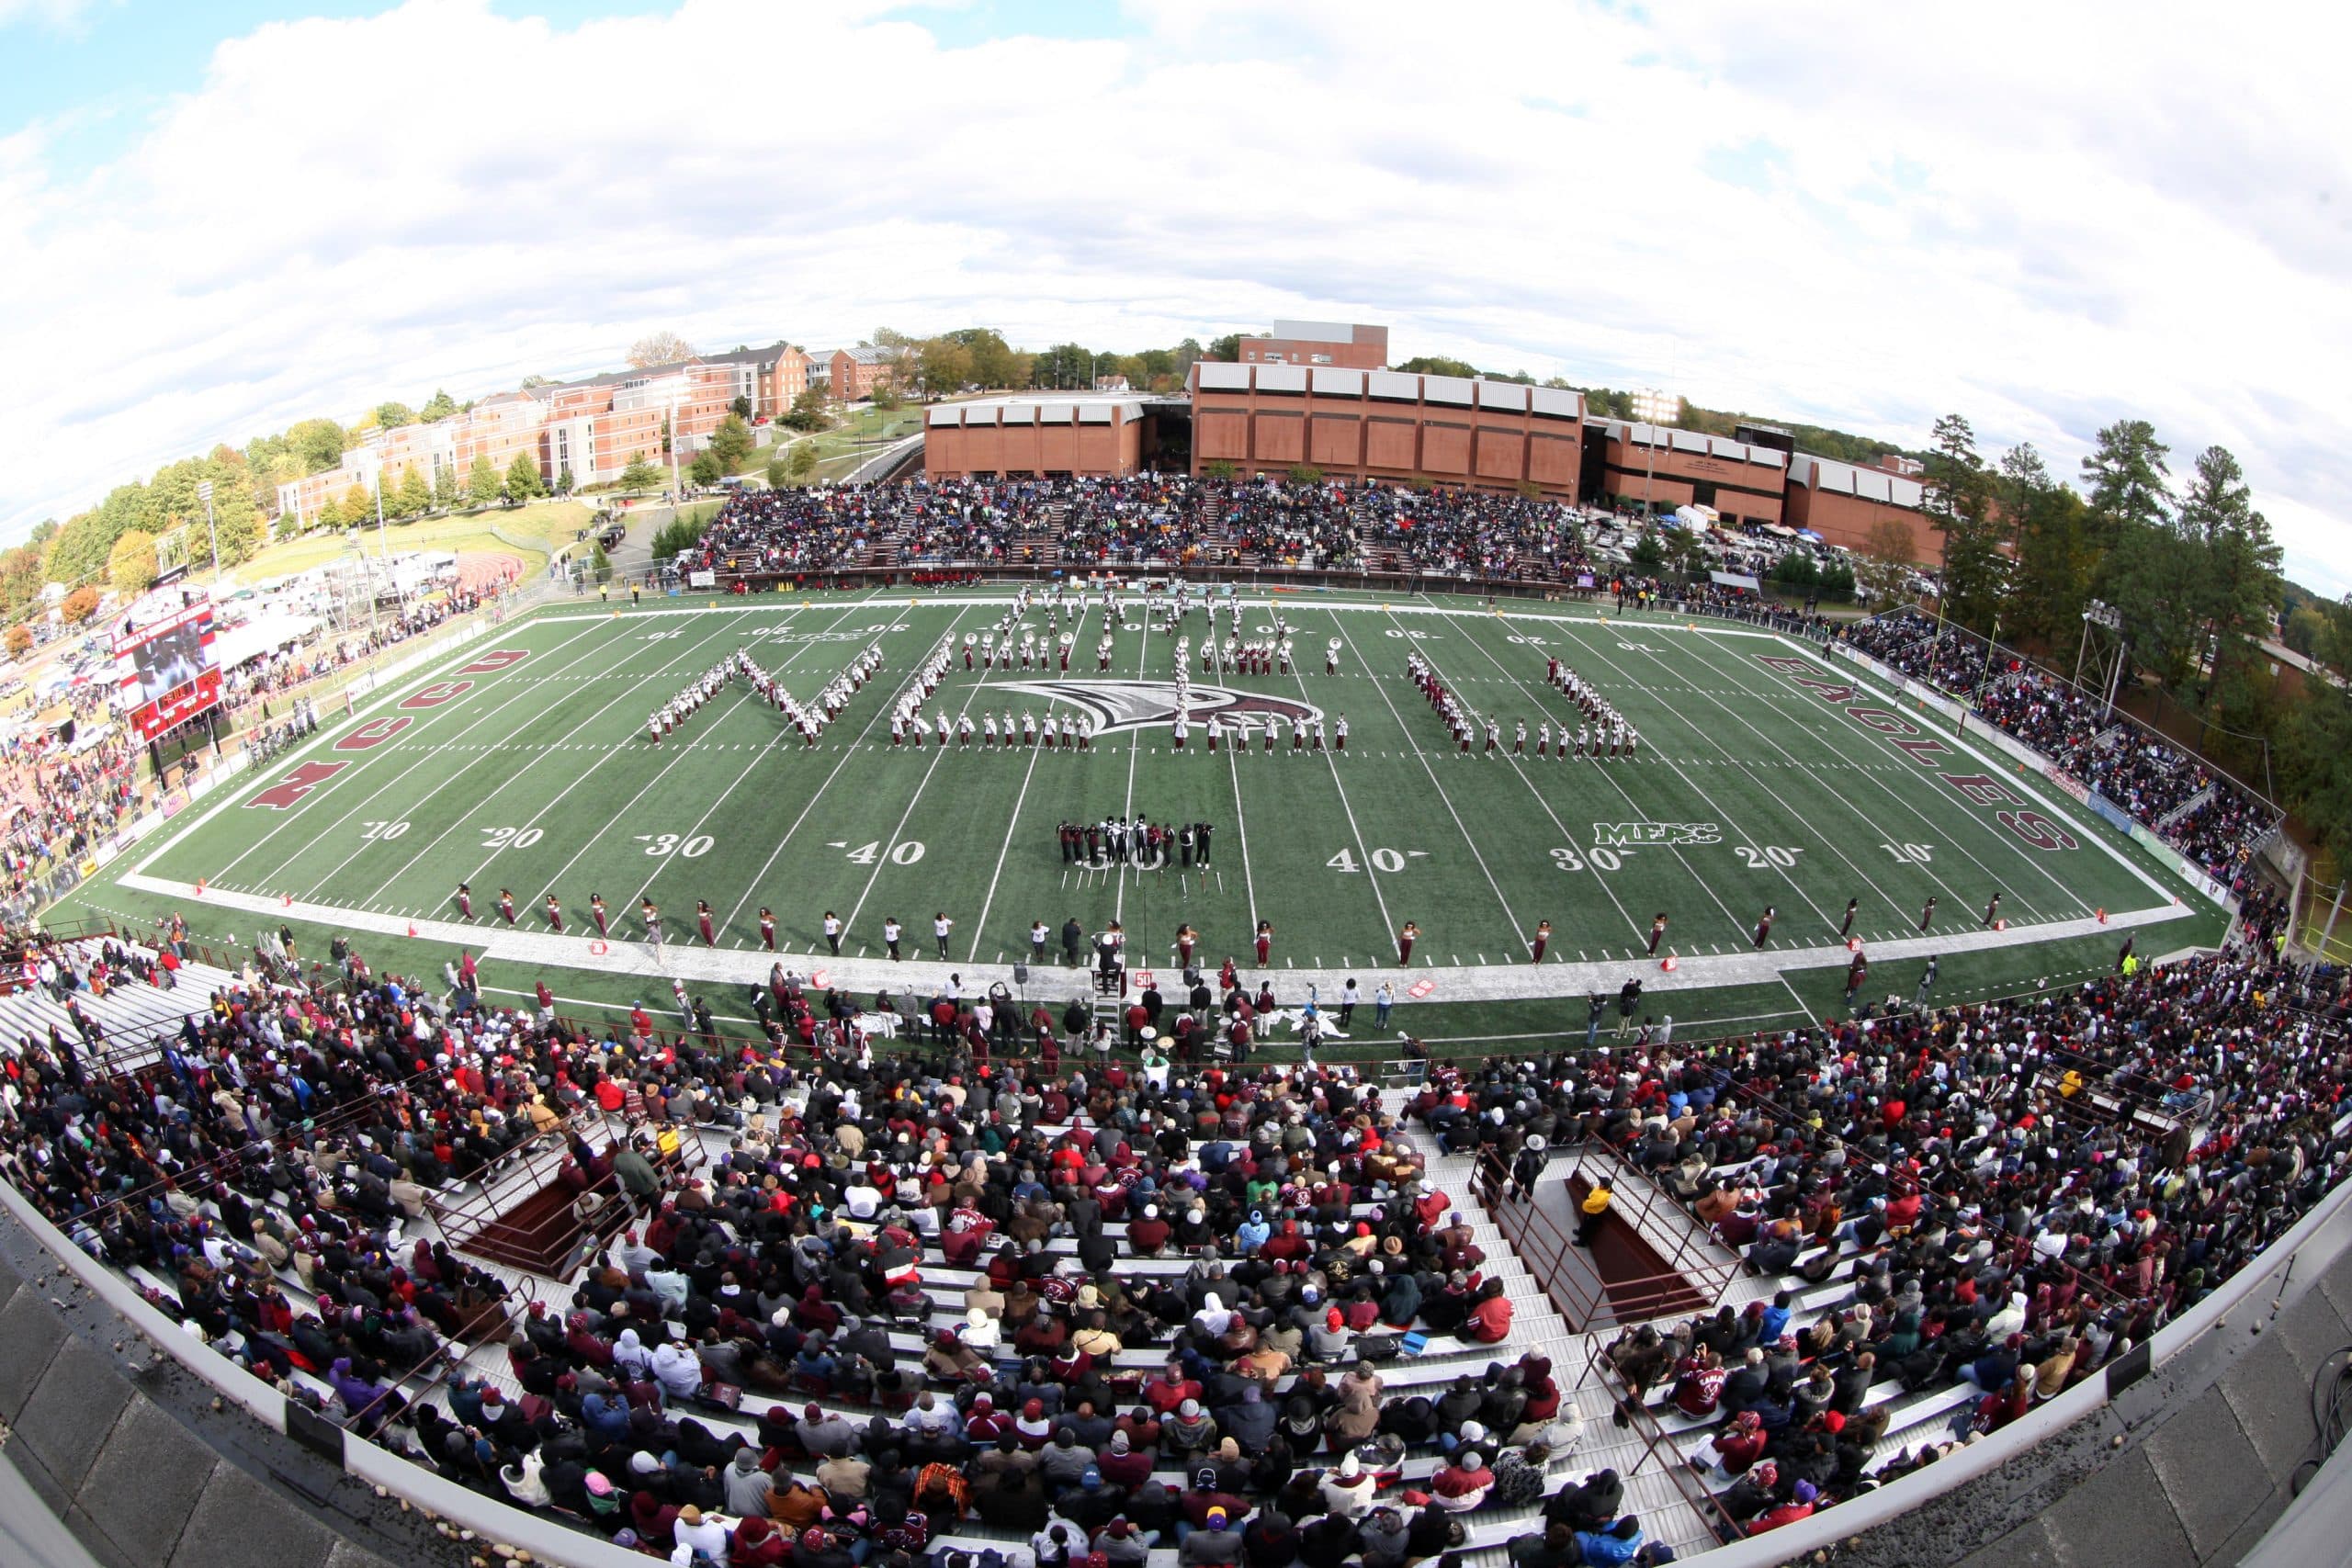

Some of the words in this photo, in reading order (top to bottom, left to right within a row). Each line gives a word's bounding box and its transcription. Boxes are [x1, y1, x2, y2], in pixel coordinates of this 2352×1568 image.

[243, 649, 531, 810] NCCU
[1753, 654, 2078, 852] EAGLES
[360, 820, 411, 840] 10
[481, 828, 544, 848] 20
[1593, 821, 1722, 847] MEAC
[645, 834, 715, 857] 30
[846, 840, 925, 864] 40
[1083, 842, 1164, 871] 50
[1734, 846, 1795, 867] 20
[1880, 842, 1932, 863] 10
[1326, 848, 1405, 872] 40
[1549, 847, 1622, 871] 30
[1851, 940, 1860, 951] 20
[1136, 974, 1151, 986] 50
